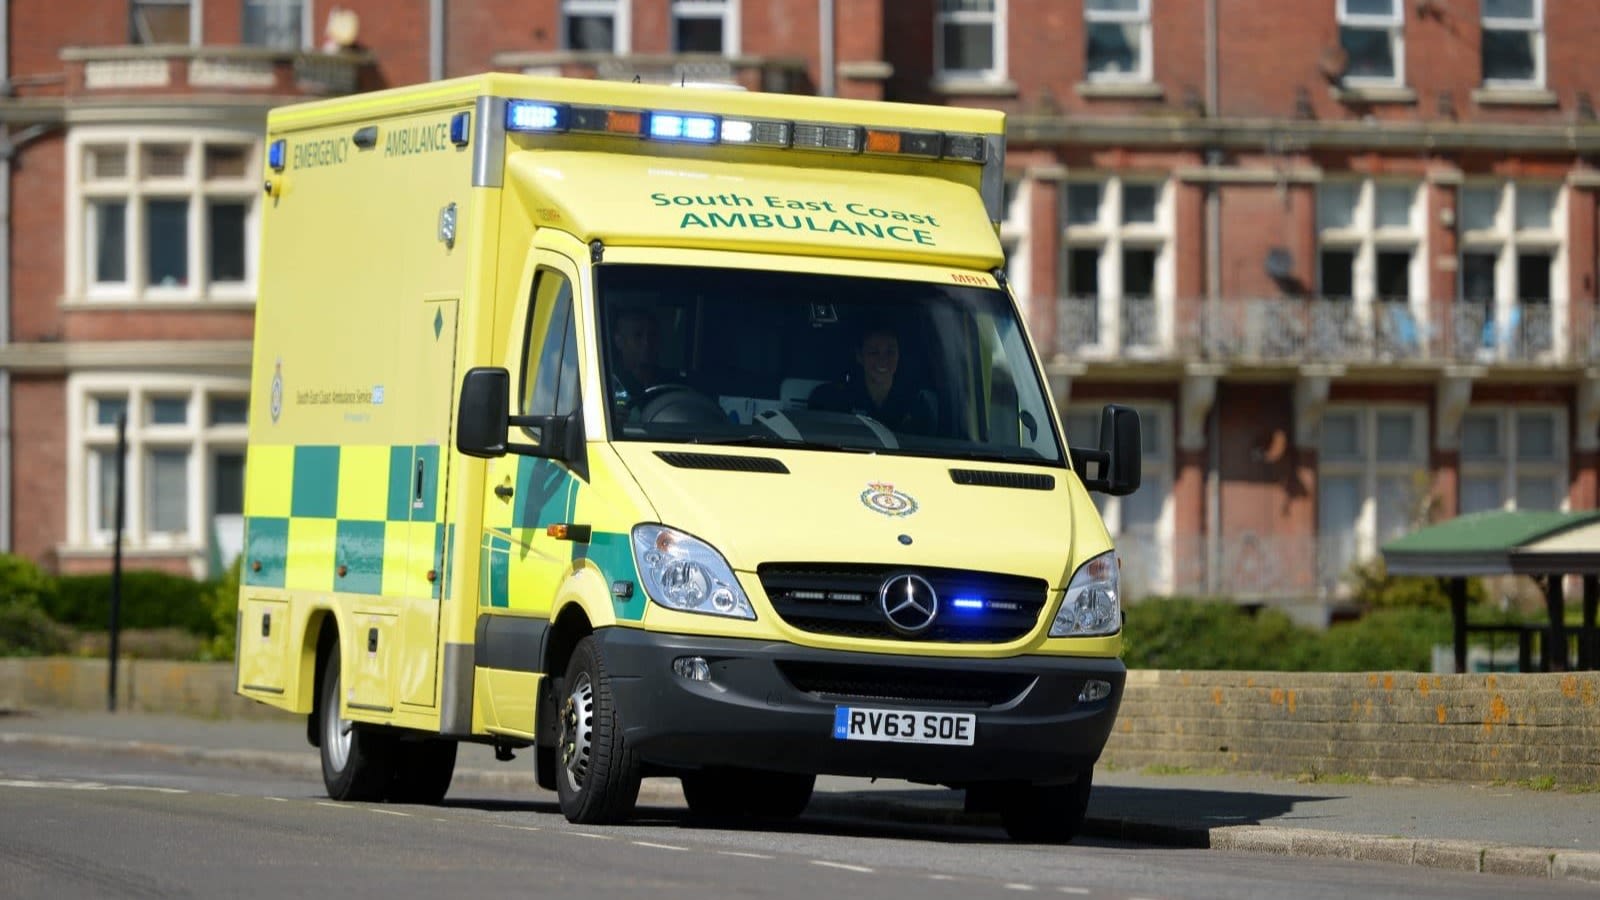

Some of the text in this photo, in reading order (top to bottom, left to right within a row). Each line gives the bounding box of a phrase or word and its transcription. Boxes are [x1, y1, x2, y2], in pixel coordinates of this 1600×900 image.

[293, 123, 447, 169] EMERGENCY AMBULANCE
[650, 192, 940, 227] South East Coast
[679, 212, 937, 246] AMBULANCE
[951, 273, 989, 286] MRH
[850, 711, 970, 740] RV63 SOE
